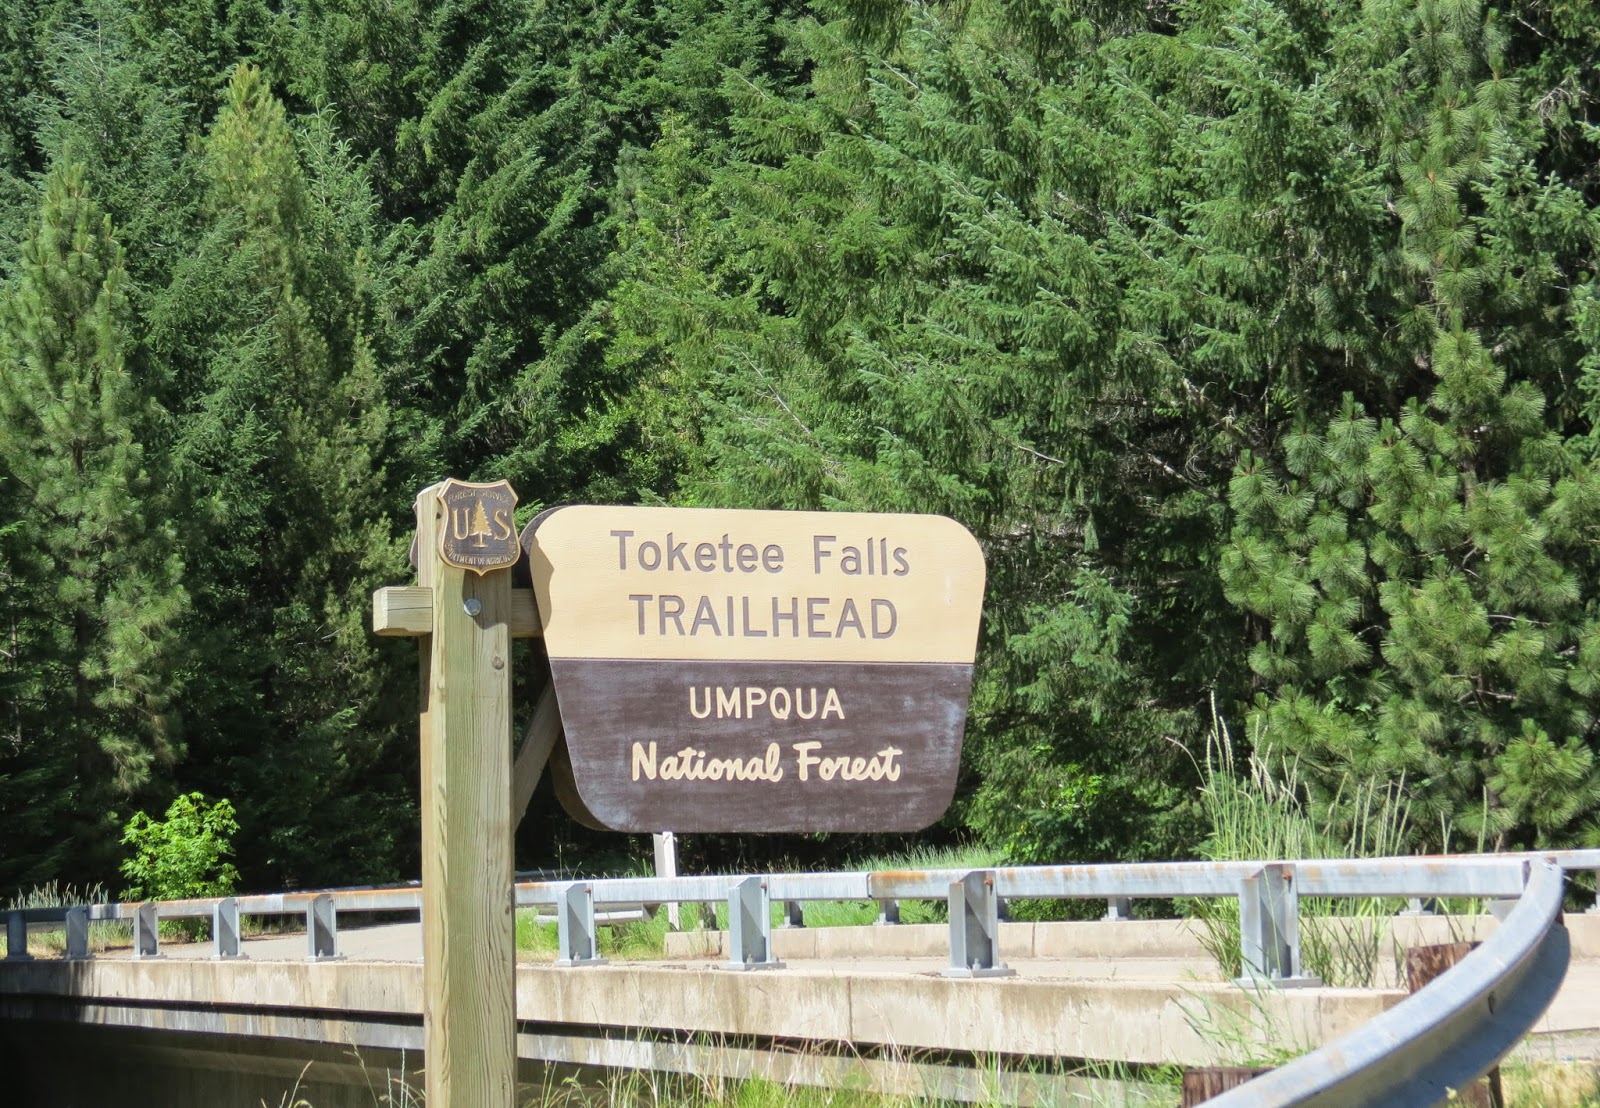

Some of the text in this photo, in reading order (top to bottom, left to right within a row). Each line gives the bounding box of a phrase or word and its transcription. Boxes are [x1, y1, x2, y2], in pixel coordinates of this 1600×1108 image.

[447, 488, 476, 504] FOREST
[452, 508, 511, 541] U S
[610, 529, 910, 577] Toketee Falls
[628, 593, 898, 639] TRAILHEAD
[689, 686, 846, 721] UMPQUA
[631, 740, 904, 783] National Forest
